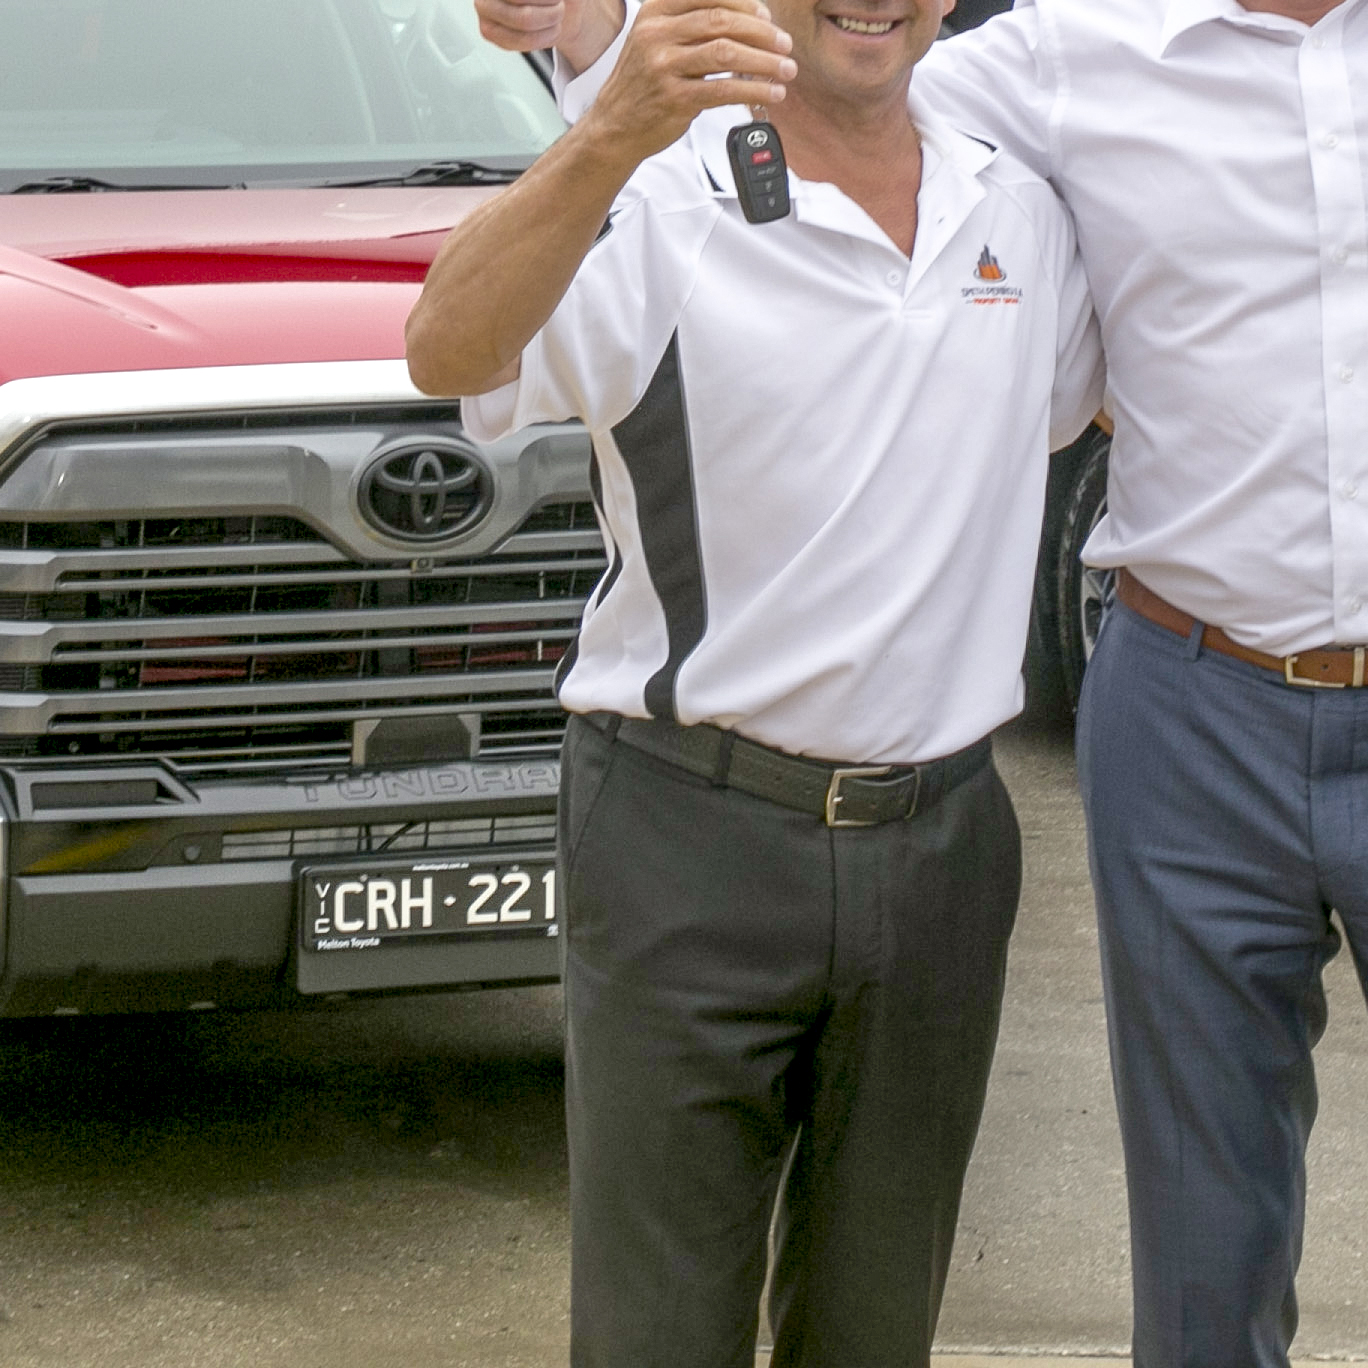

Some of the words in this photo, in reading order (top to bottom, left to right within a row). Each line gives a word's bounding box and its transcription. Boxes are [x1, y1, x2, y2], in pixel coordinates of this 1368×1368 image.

[287, 762, 559, 803] TUNDRA
[315, 882, 330, 934] VIC
[317, 938, 350, 951] Melton
[351, 936, 381, 949] Toyota
